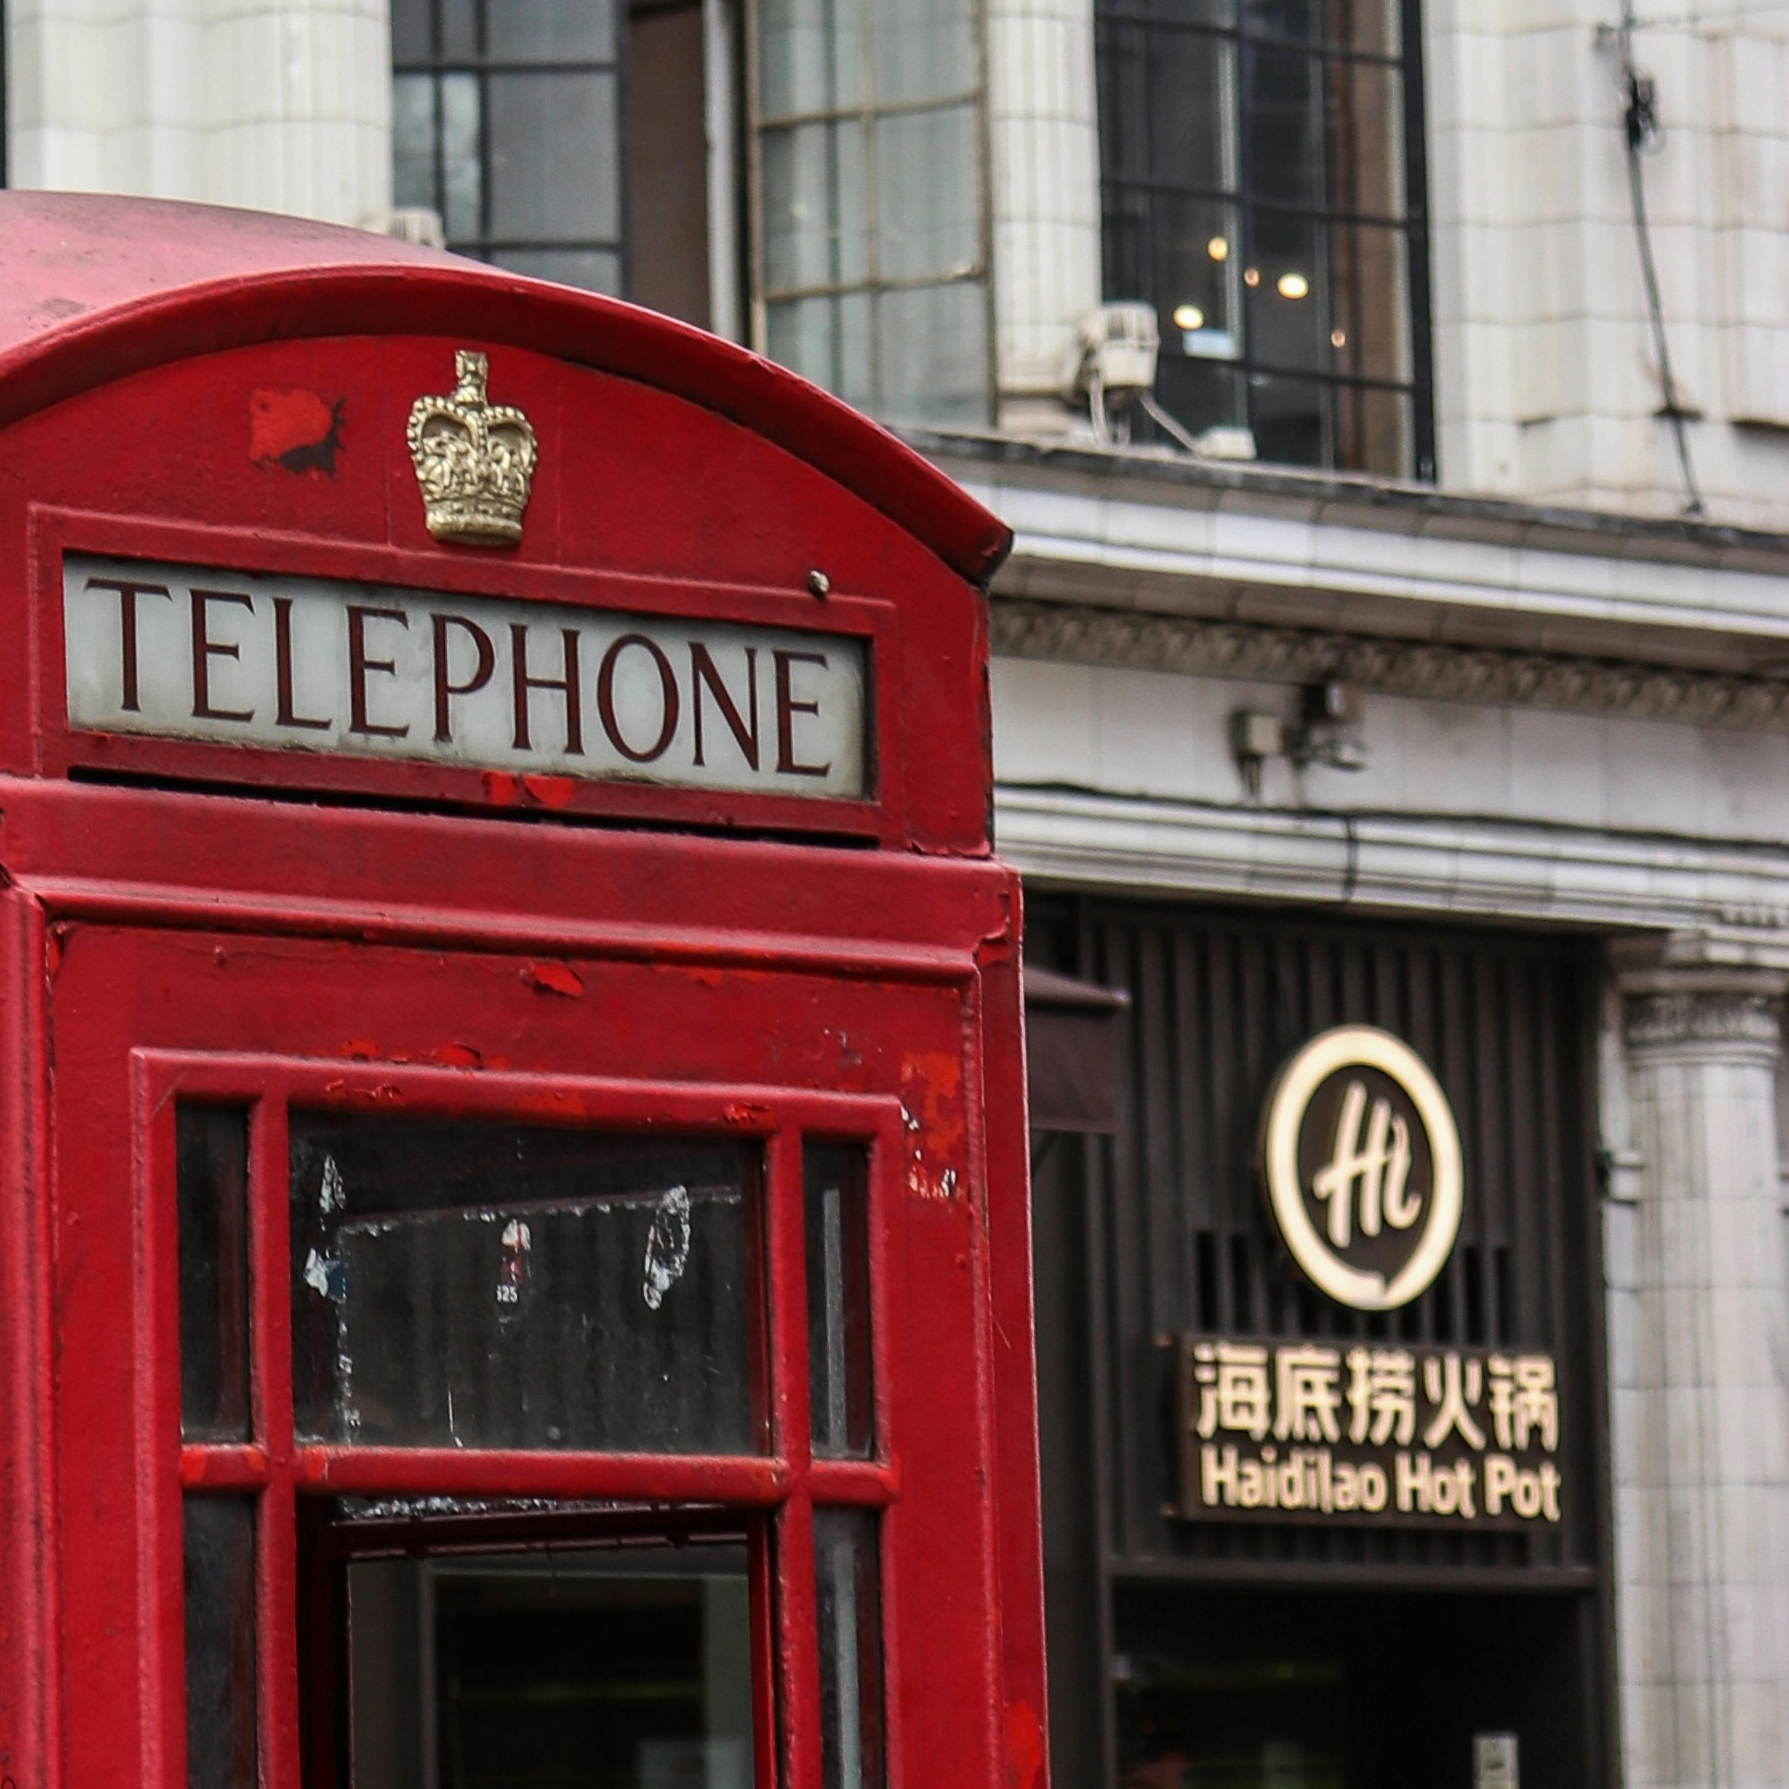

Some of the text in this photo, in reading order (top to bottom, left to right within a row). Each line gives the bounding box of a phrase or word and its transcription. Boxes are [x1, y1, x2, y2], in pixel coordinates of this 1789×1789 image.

[84, 576, 830, 778] TELEPHONE
[1193, 1342, 1560, 1452] 海底捞火锅
[1200, 1443, 1561, 1523] Haidilao Hot Pot
